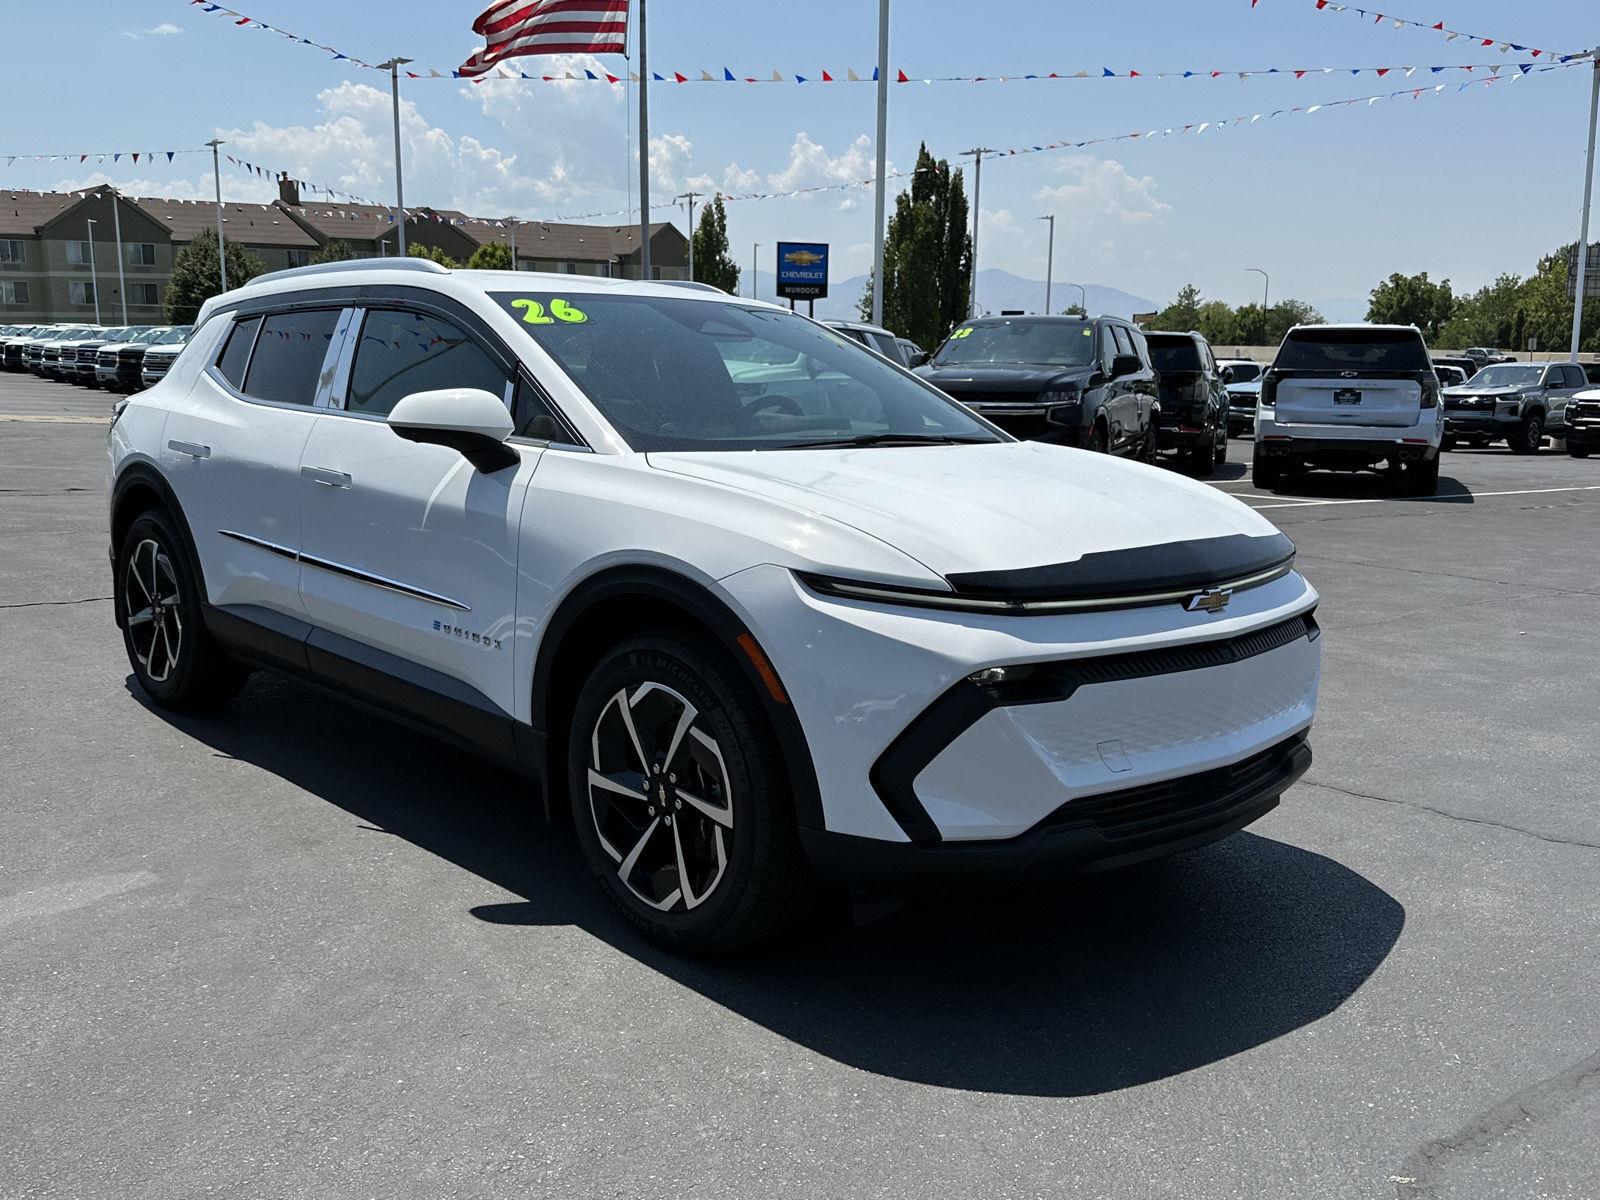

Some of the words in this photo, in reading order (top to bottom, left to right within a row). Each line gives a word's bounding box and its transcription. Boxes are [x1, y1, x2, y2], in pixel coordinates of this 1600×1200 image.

[781, 271, 824, 279] CHEVROLET
[785, 286, 820, 294] MURDOCK
[511, 298, 588, 325] 26
